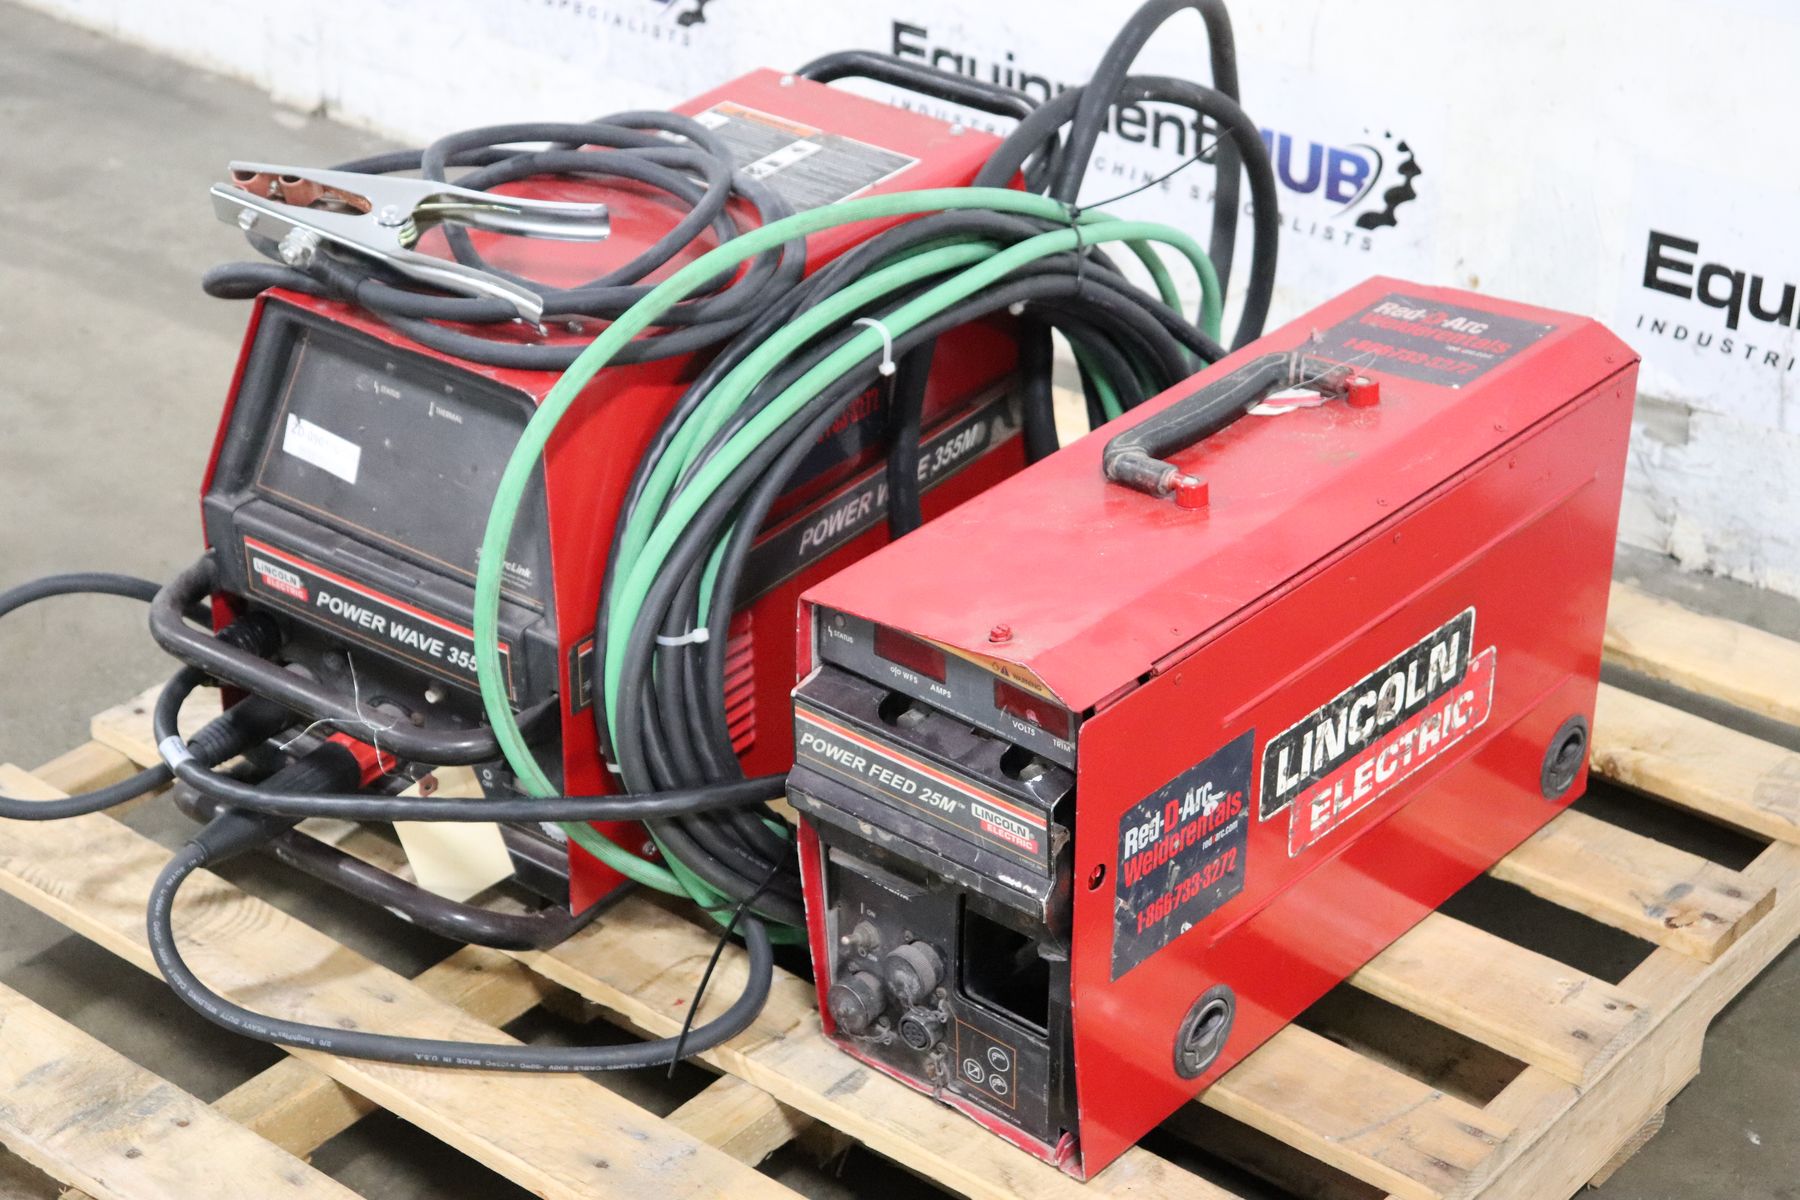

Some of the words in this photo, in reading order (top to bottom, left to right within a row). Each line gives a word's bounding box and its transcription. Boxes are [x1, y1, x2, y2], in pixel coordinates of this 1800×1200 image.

[892, 19, 1217, 166] Equipent
[798, 490, 873, 556] POWER
[254, 560, 299, 587] LINCOLN
[316, 590, 387, 634] POWER
[388, 620, 445, 658] WAVE
[902, 671, 919, 684] WFS
[930, 683, 952, 699] AMPS
[1012, 720, 1036, 737] VOLTS
[1276, 631, 1460, 797] LINCOLN
[800, 732, 865, 773] POWER
[867, 764, 918, 796] FEED
[1052, 738, 1071, 752] TRIM
[1309, 690, 1475, 832] ELECTRIC
[974, 805, 1027, 836] LINCOLN
[986, 824, 1034, 851] ELECTRIC
[1123, 790, 1243, 889] Welderentals
[1124, 781, 1213, 860] Red-D-Arc
[456, 1057, 481, 1066] MADE
